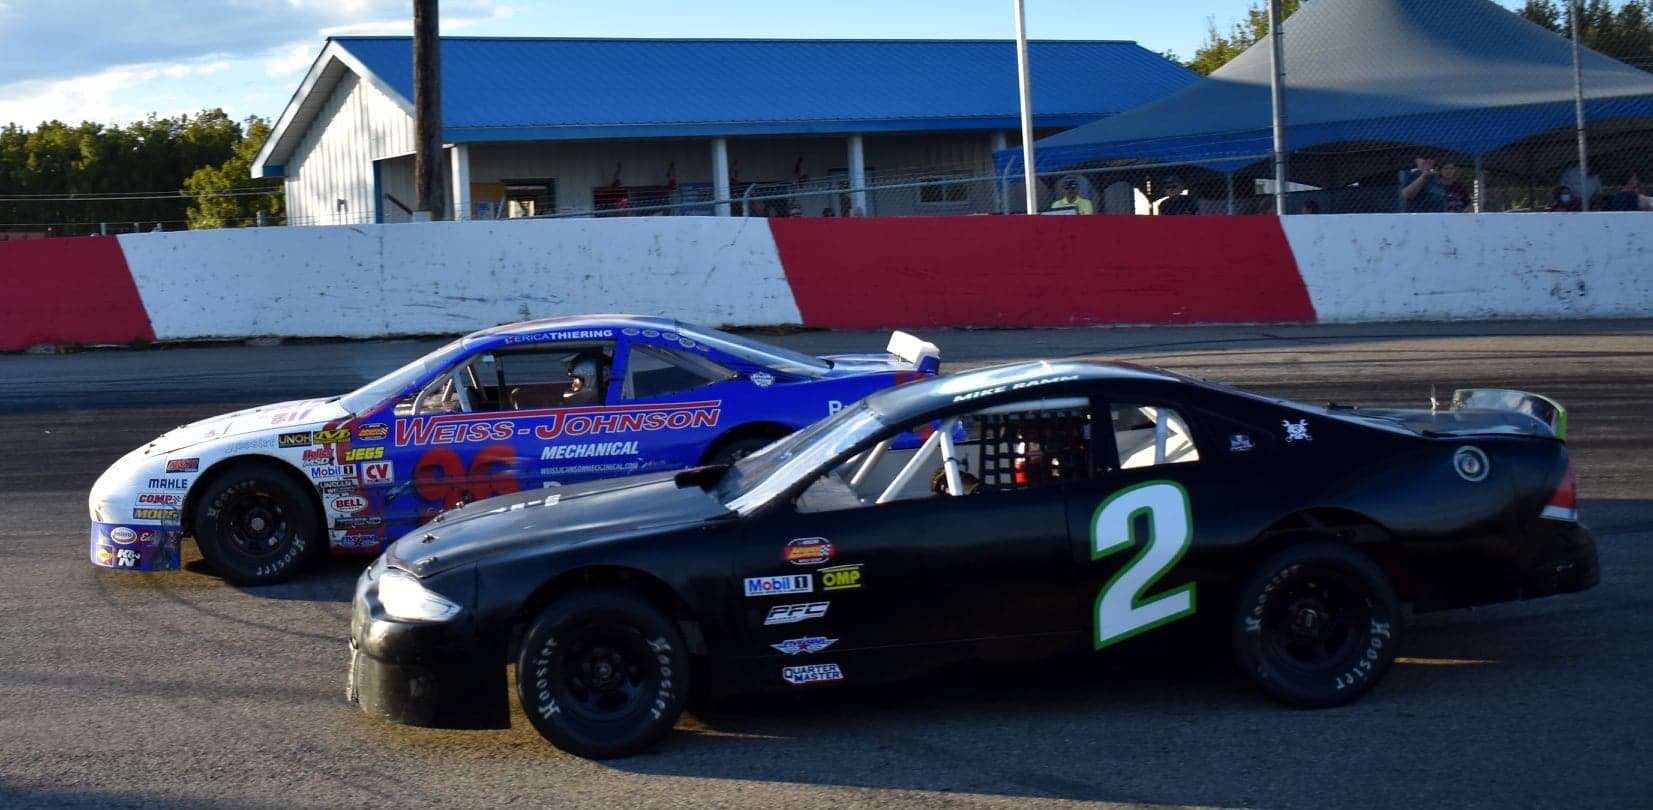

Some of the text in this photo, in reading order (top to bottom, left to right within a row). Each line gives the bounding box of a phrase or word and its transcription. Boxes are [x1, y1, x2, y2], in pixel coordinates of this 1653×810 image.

[953, 374, 1080, 402] MIKE RAMM
[395, 415, 514, 446] WEISS
[535, 408, 721, 440] JOHNSON
[279, 433, 311, 446] UNOH
[345, 446, 385, 461] JEGS
[541, 441, 639, 460] MECHANICAL
[311, 465, 341, 477] Mobil
[366, 463, 389, 480] CV
[148, 478, 188, 489] MAHLE
[138, 494, 173, 504] COMP
[336, 499, 363, 508] BELL
[1090, 479, 1198, 651] 2
[748, 575, 808, 593] Mobil 1
[822, 571, 861, 587] OMP
[768, 602, 830, 619] PFC
[1336, 617, 1390, 690] Hoosier
[536, 637, 561, 719] Hoosier
[648, 636, 672, 719] Hoosier
[783, 664, 836, 679] QUARTER
[794, 671, 840, 683] MASTER
